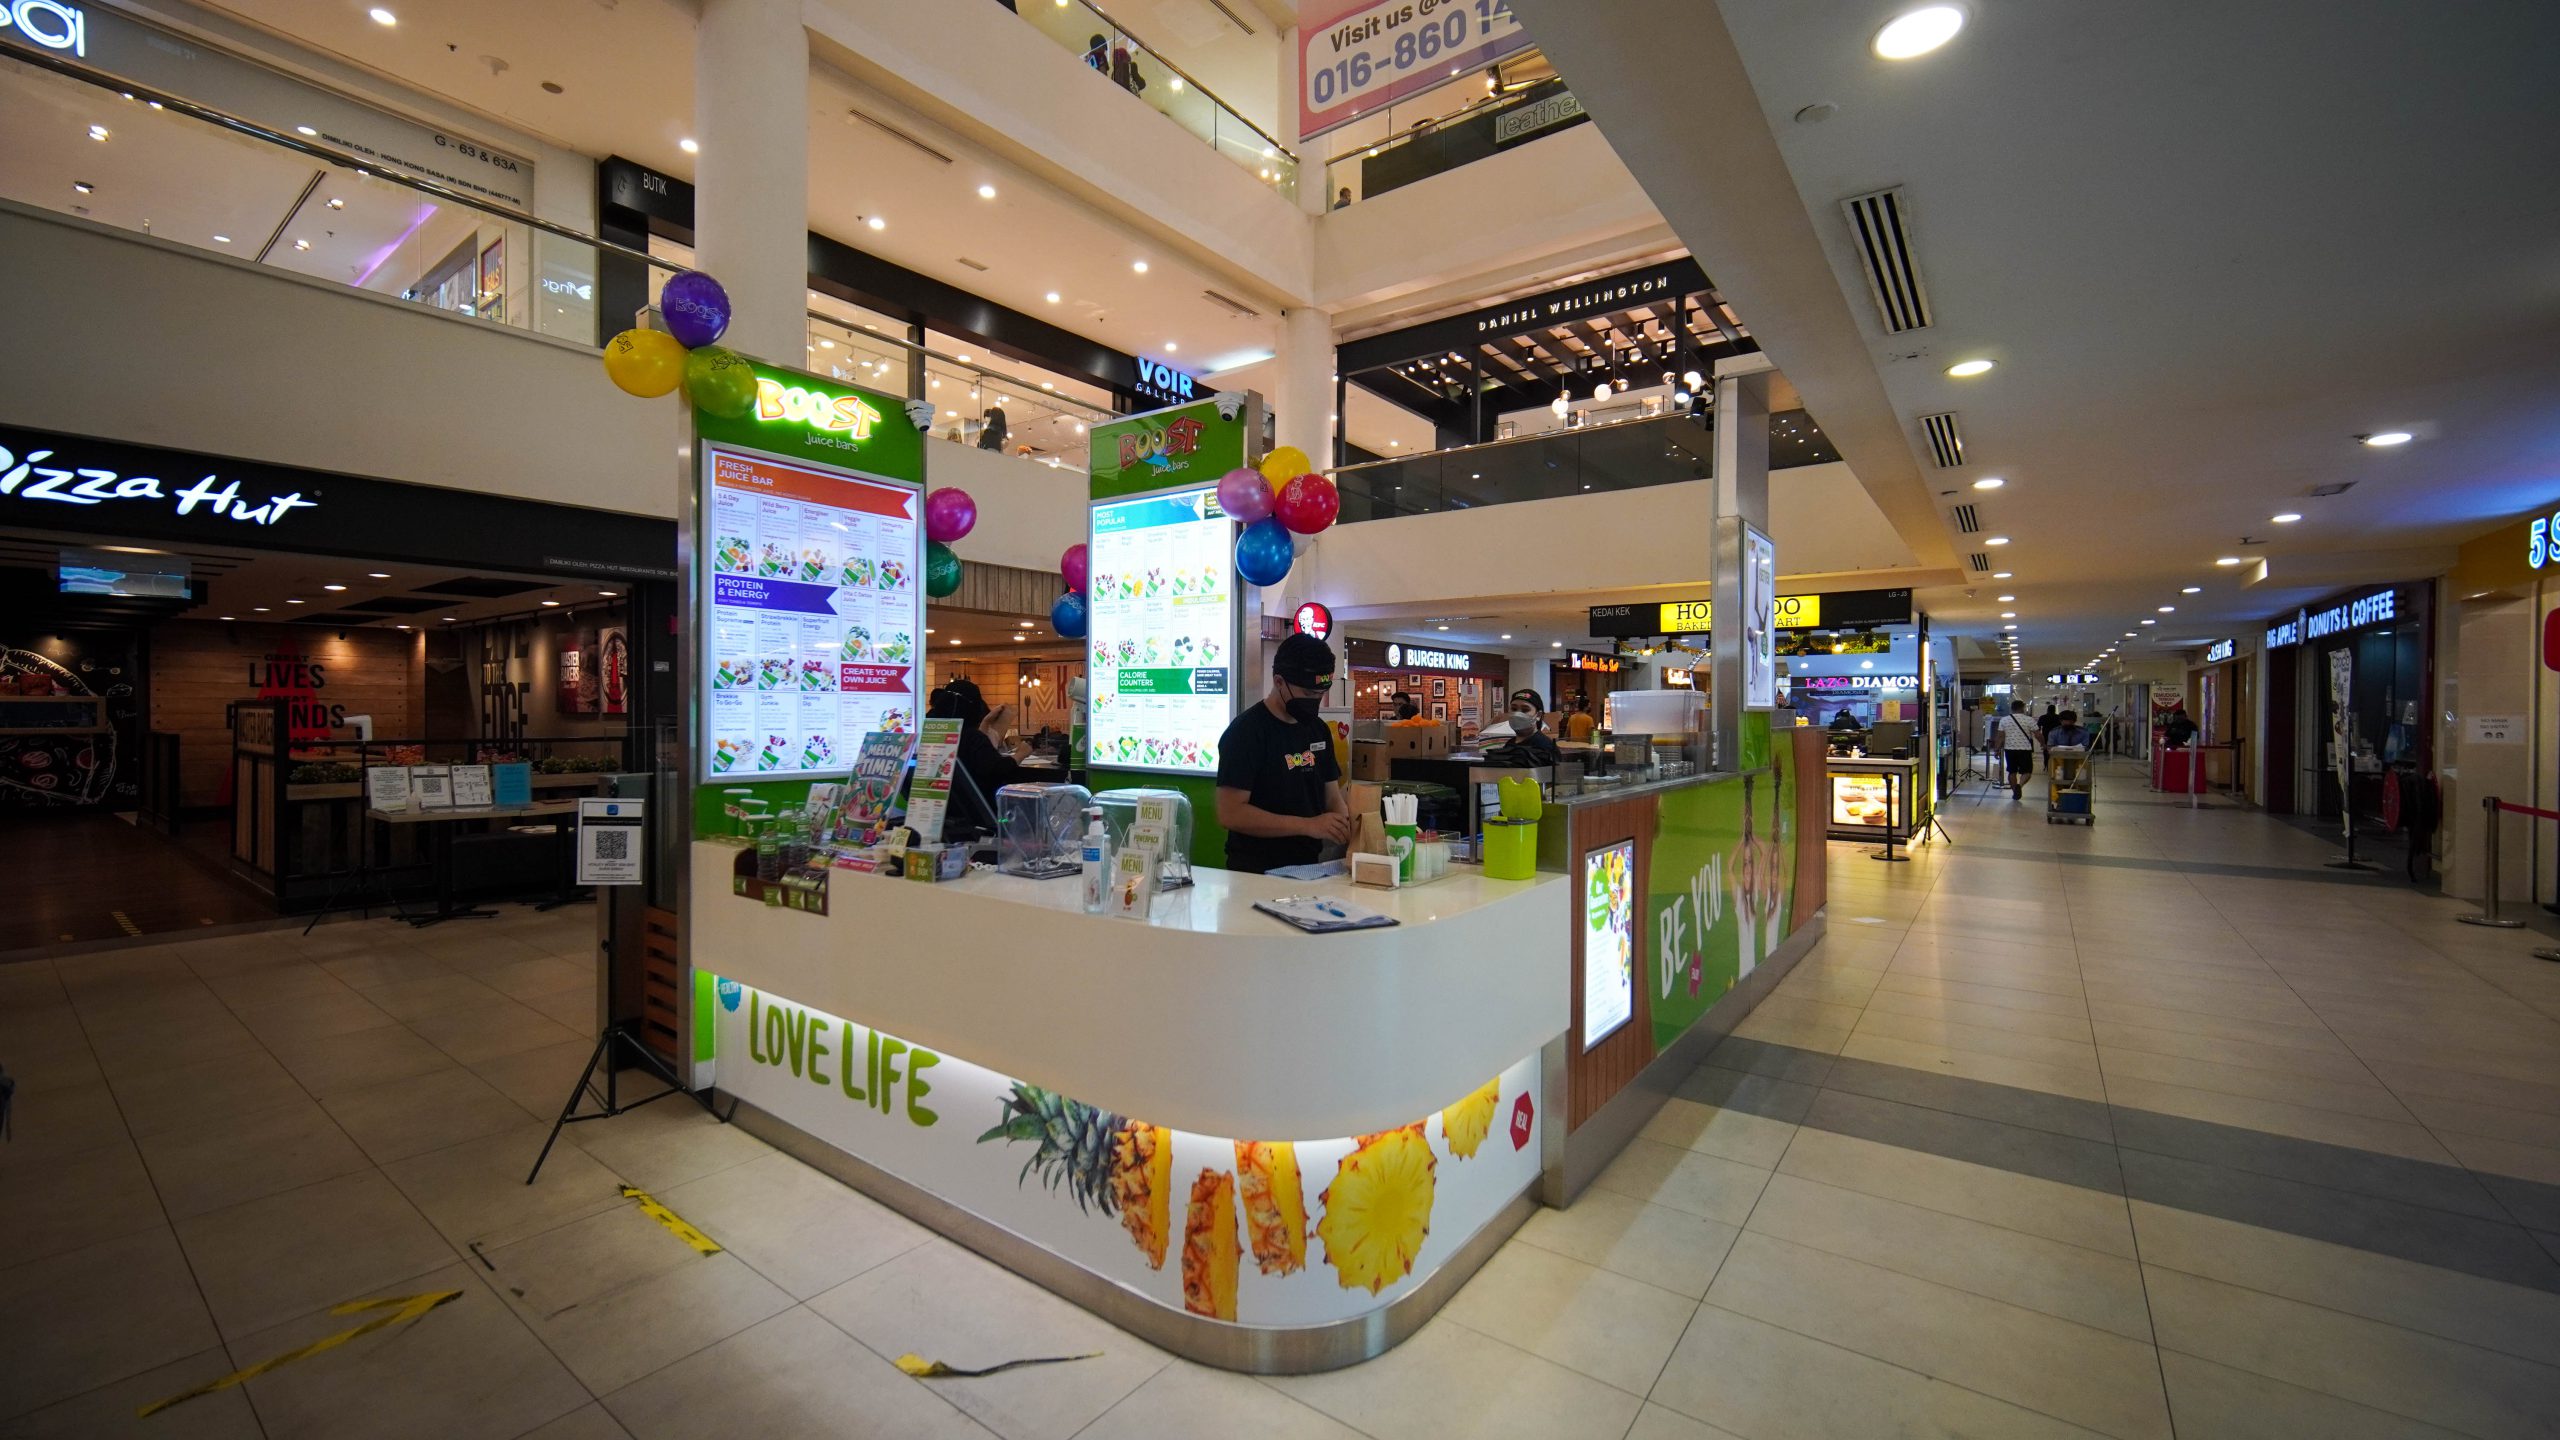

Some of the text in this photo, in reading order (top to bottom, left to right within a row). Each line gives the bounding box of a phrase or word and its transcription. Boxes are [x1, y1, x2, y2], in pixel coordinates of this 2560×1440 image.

[1330, 17, 1381, 53] Visit
[1385, 5, 1413, 30] us
[1313, 9, 1467, 104] 016-860
[435, 134, 446, 147] G
[459, 143, 476, 158] 63
[480, 151, 490, 163] &
[492, 156, 518, 173] 63A
[381, 153, 402, 166] HONG
[403, 160, 425, 174] KONG
[426, 168, 445, 180] SASA
[458, 179, 472, 189] SDN
[473, 184, 487, 194] BHD
[643, 172, 667, 197] BUTIK
[1479, 276, 1668, 331] DANIEL WELLINGTON
[1137, 356, 1194, 399] VOIR
[1136, 382, 1186, 405] GALLER
[756, 377, 882, 439] BOOST
[836, 438, 859, 452] bars
[1119, 415, 1206, 470] BOOST
[719, 459, 753, 473] FRESH
[1172, 460, 1189, 471] bars
[719, 470, 774, 486] JUICE BAR
[161, 474, 318, 526] Hut
[1096, 510, 1114, 519] MOST
[1097, 515, 1126, 526] POPULAR
[718, 578, 763, 590] PROTEIN
[718, 588, 770, 600] & ENERGY
[1592, 606, 1631, 618] KEDAI KEK
[2277, 622, 2297, 647] APPLE
[2308, 608, 2340, 639] DONUTS
[2341, 604, 2348, 628] &
[2352, 589, 2395, 627] COFFEE
[1775, 617, 1801, 627] ART
[561, 651, 579, 666] MASTER
[1407, 649, 1469, 670] BURGER KING
[249, 662, 325, 689] LIVES
[561, 666, 579, 681] BAKERS
[843, 667, 897, 677] CREATE YOUR
[843, 675, 887, 685] OWN JUICE
[1120, 671, 1147, 679] CALORIE
[1120, 678, 1154, 686] COUNTERS
[1805, 676, 1919, 688] LAZO DIAMON
[866, 744, 902, 757] MELON
[861, 758, 897, 777] TIME!
[1141, 806, 1163, 820] MENU
[1121, 857, 1144, 874] MENU
[1660, 853, 1722, 1000] BE YOU
[750, 989, 941, 1127] LOVE LIFE
